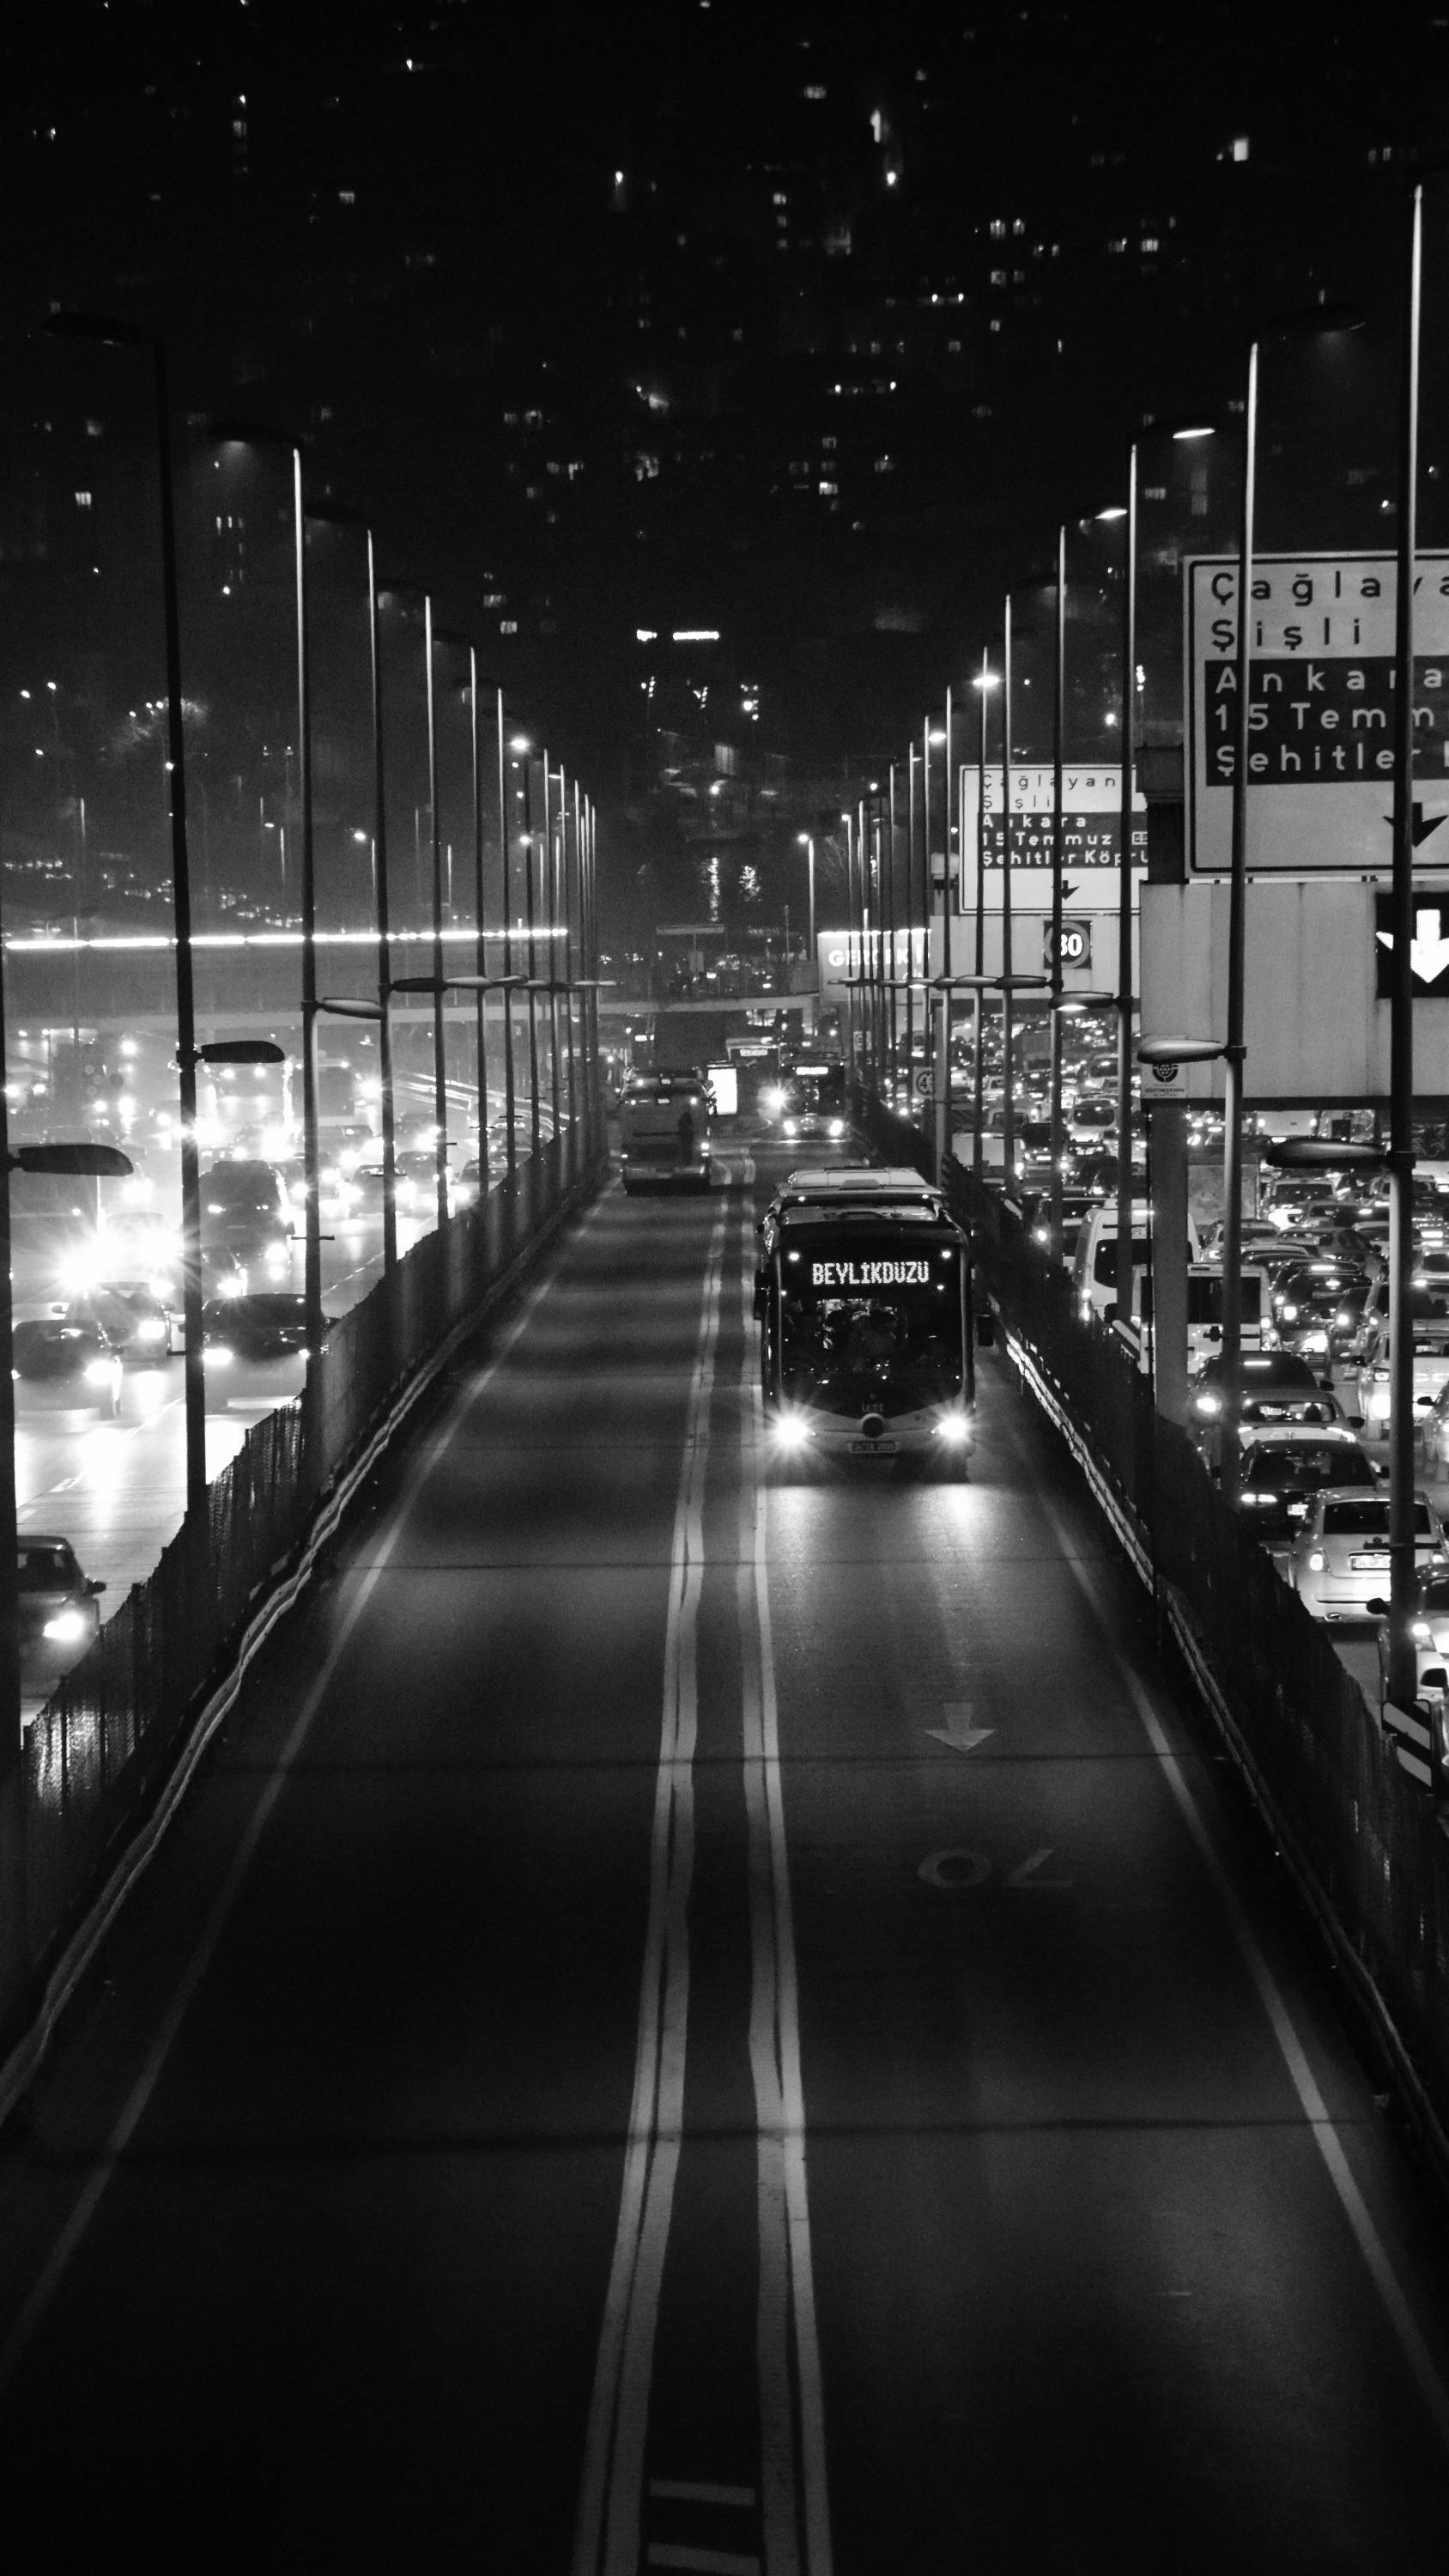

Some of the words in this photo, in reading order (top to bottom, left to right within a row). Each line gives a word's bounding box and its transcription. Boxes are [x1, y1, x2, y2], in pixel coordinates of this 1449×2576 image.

[1211, 617, 1361, 652] Şişli
[1216, 702, 1269, 731] 15
[983, 794, 1050, 809] Şşli
[1016, 831, 1112, 846] Temmuz
[983, 850, 1076, 866] Şehitlr
[812, 1261, 929, 1285] BEYLİKDÜZÜ
